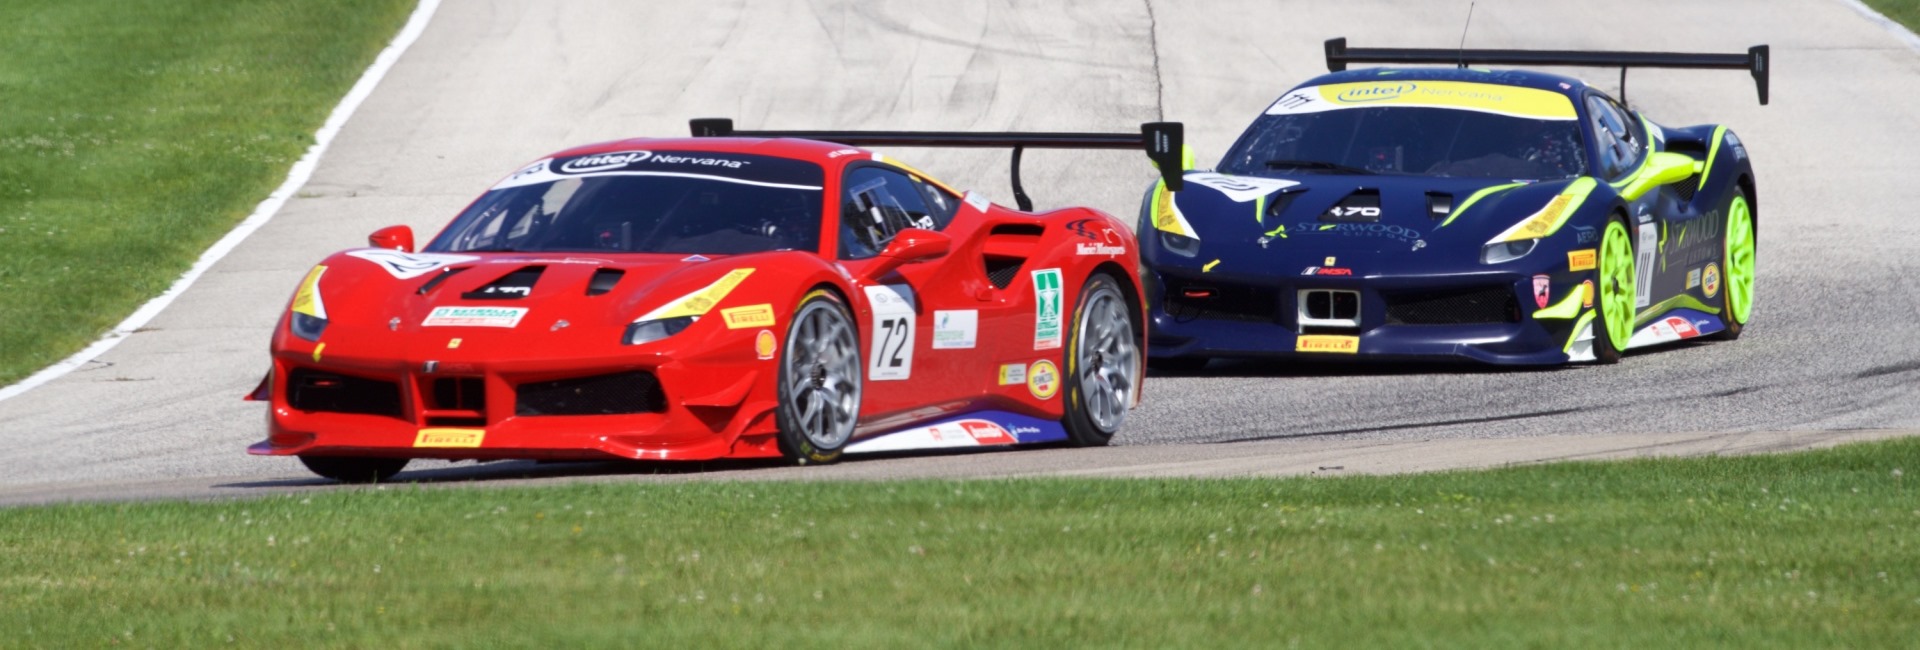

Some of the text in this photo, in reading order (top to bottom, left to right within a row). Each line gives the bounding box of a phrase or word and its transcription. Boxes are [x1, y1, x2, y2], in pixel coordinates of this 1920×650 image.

[1348, 84, 1504, 102] intel Nervana
[573, 153, 744, 169] intel Nervana
[729, 309, 770, 324] PIRELLI
[876, 317, 909, 368] 72
